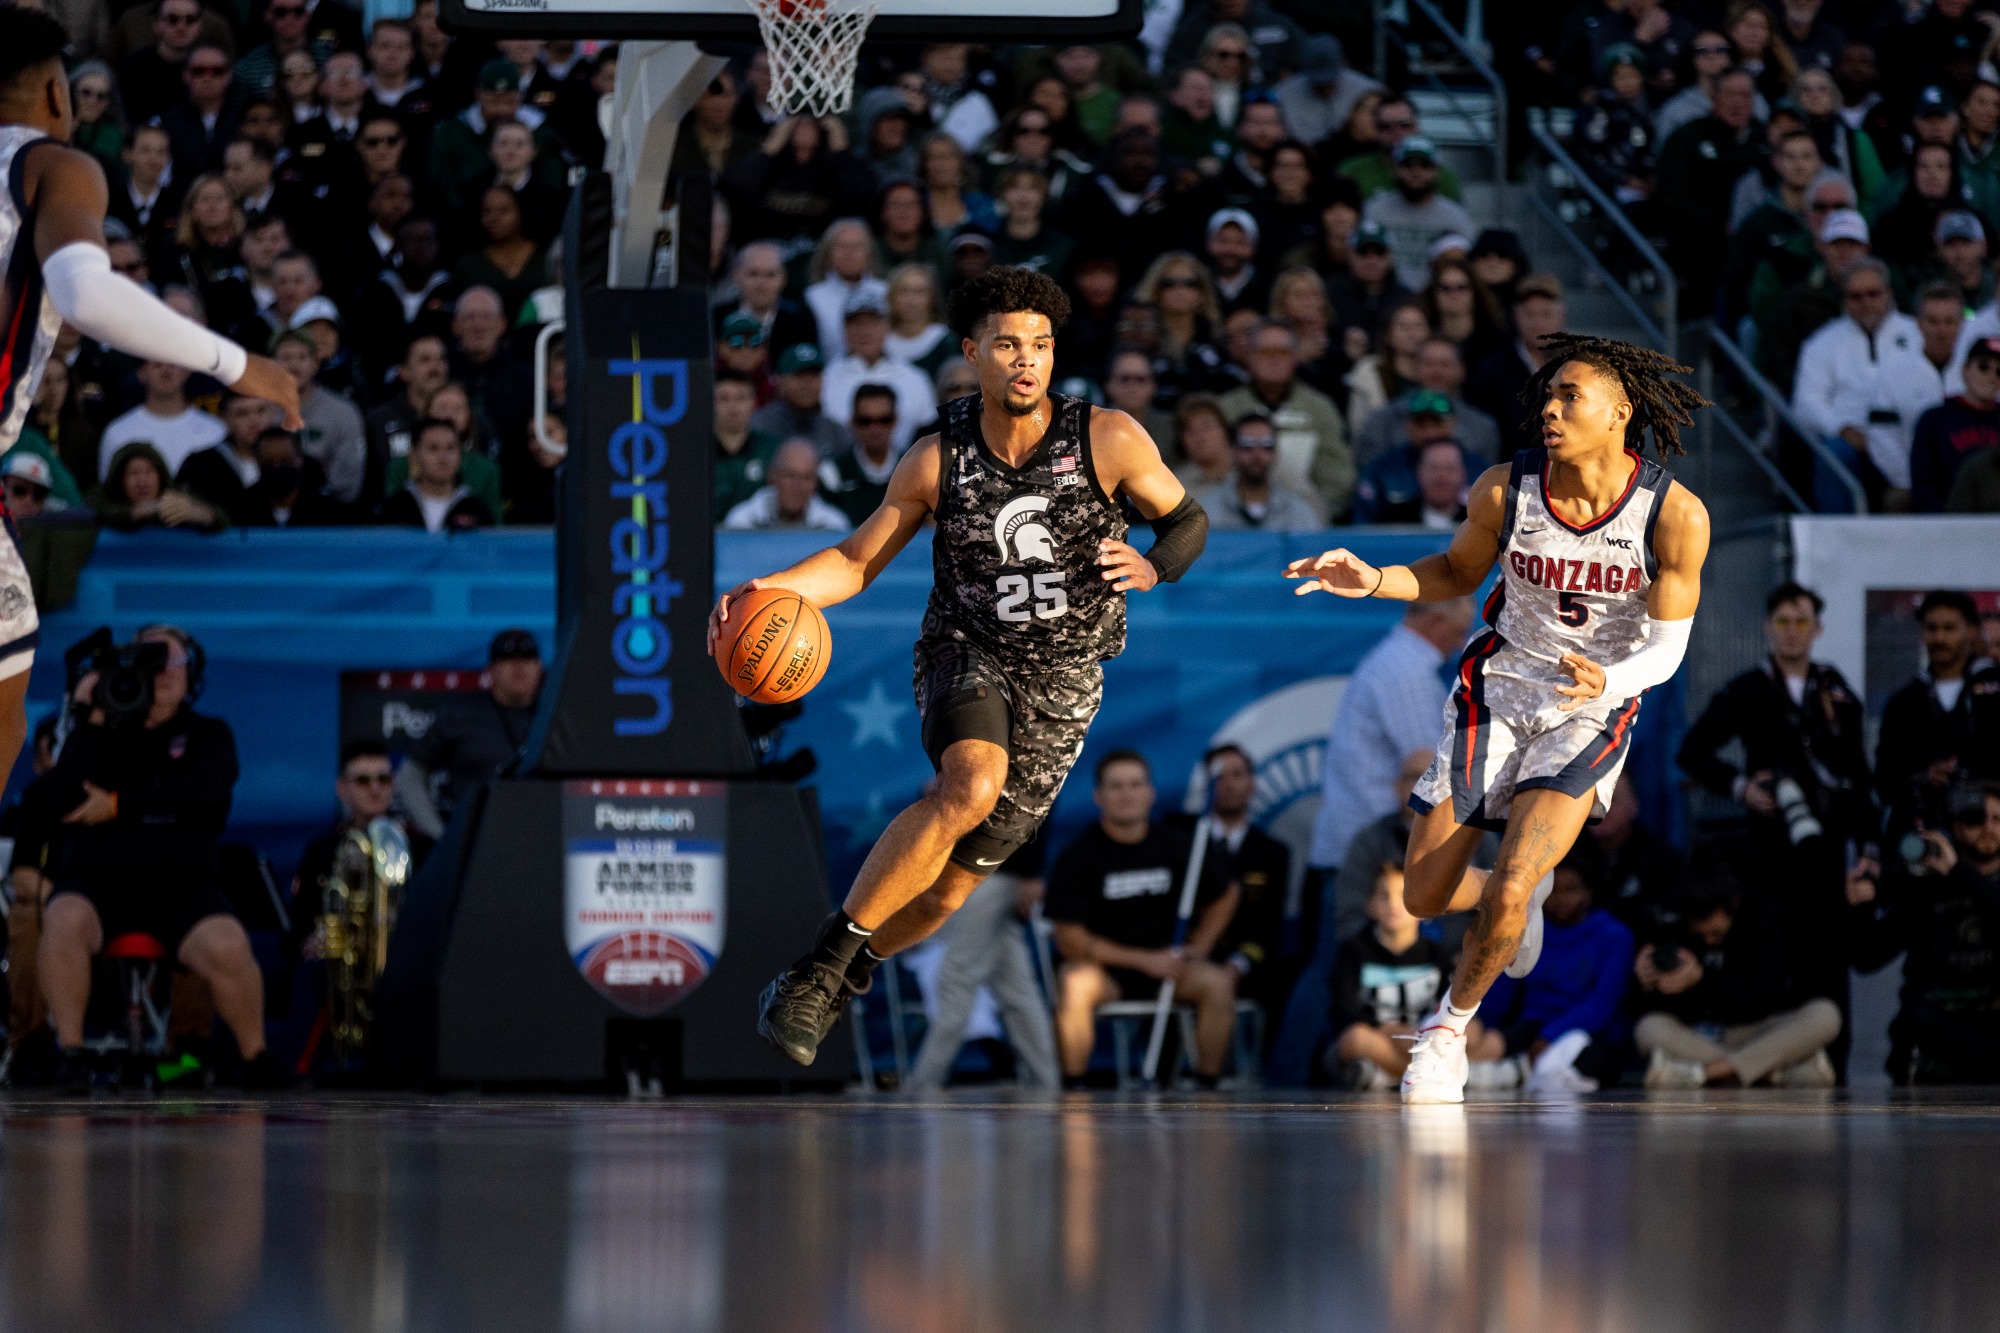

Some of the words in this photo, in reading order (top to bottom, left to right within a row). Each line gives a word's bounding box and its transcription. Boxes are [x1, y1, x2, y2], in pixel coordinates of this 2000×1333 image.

[607, 358, 689, 737] Peraton
[1606, 537, 1633, 550] WCC
[1510, 550, 1642, 593] GONZAGA
[995, 571, 1068, 621] 25
[1558, 591, 1590, 628] 5
[738, 612, 790, 685] SPALDING
[769, 634, 808, 694] LEGACY
[594, 802, 696, 832] Peraton
[604, 958, 685, 986] ESPN
